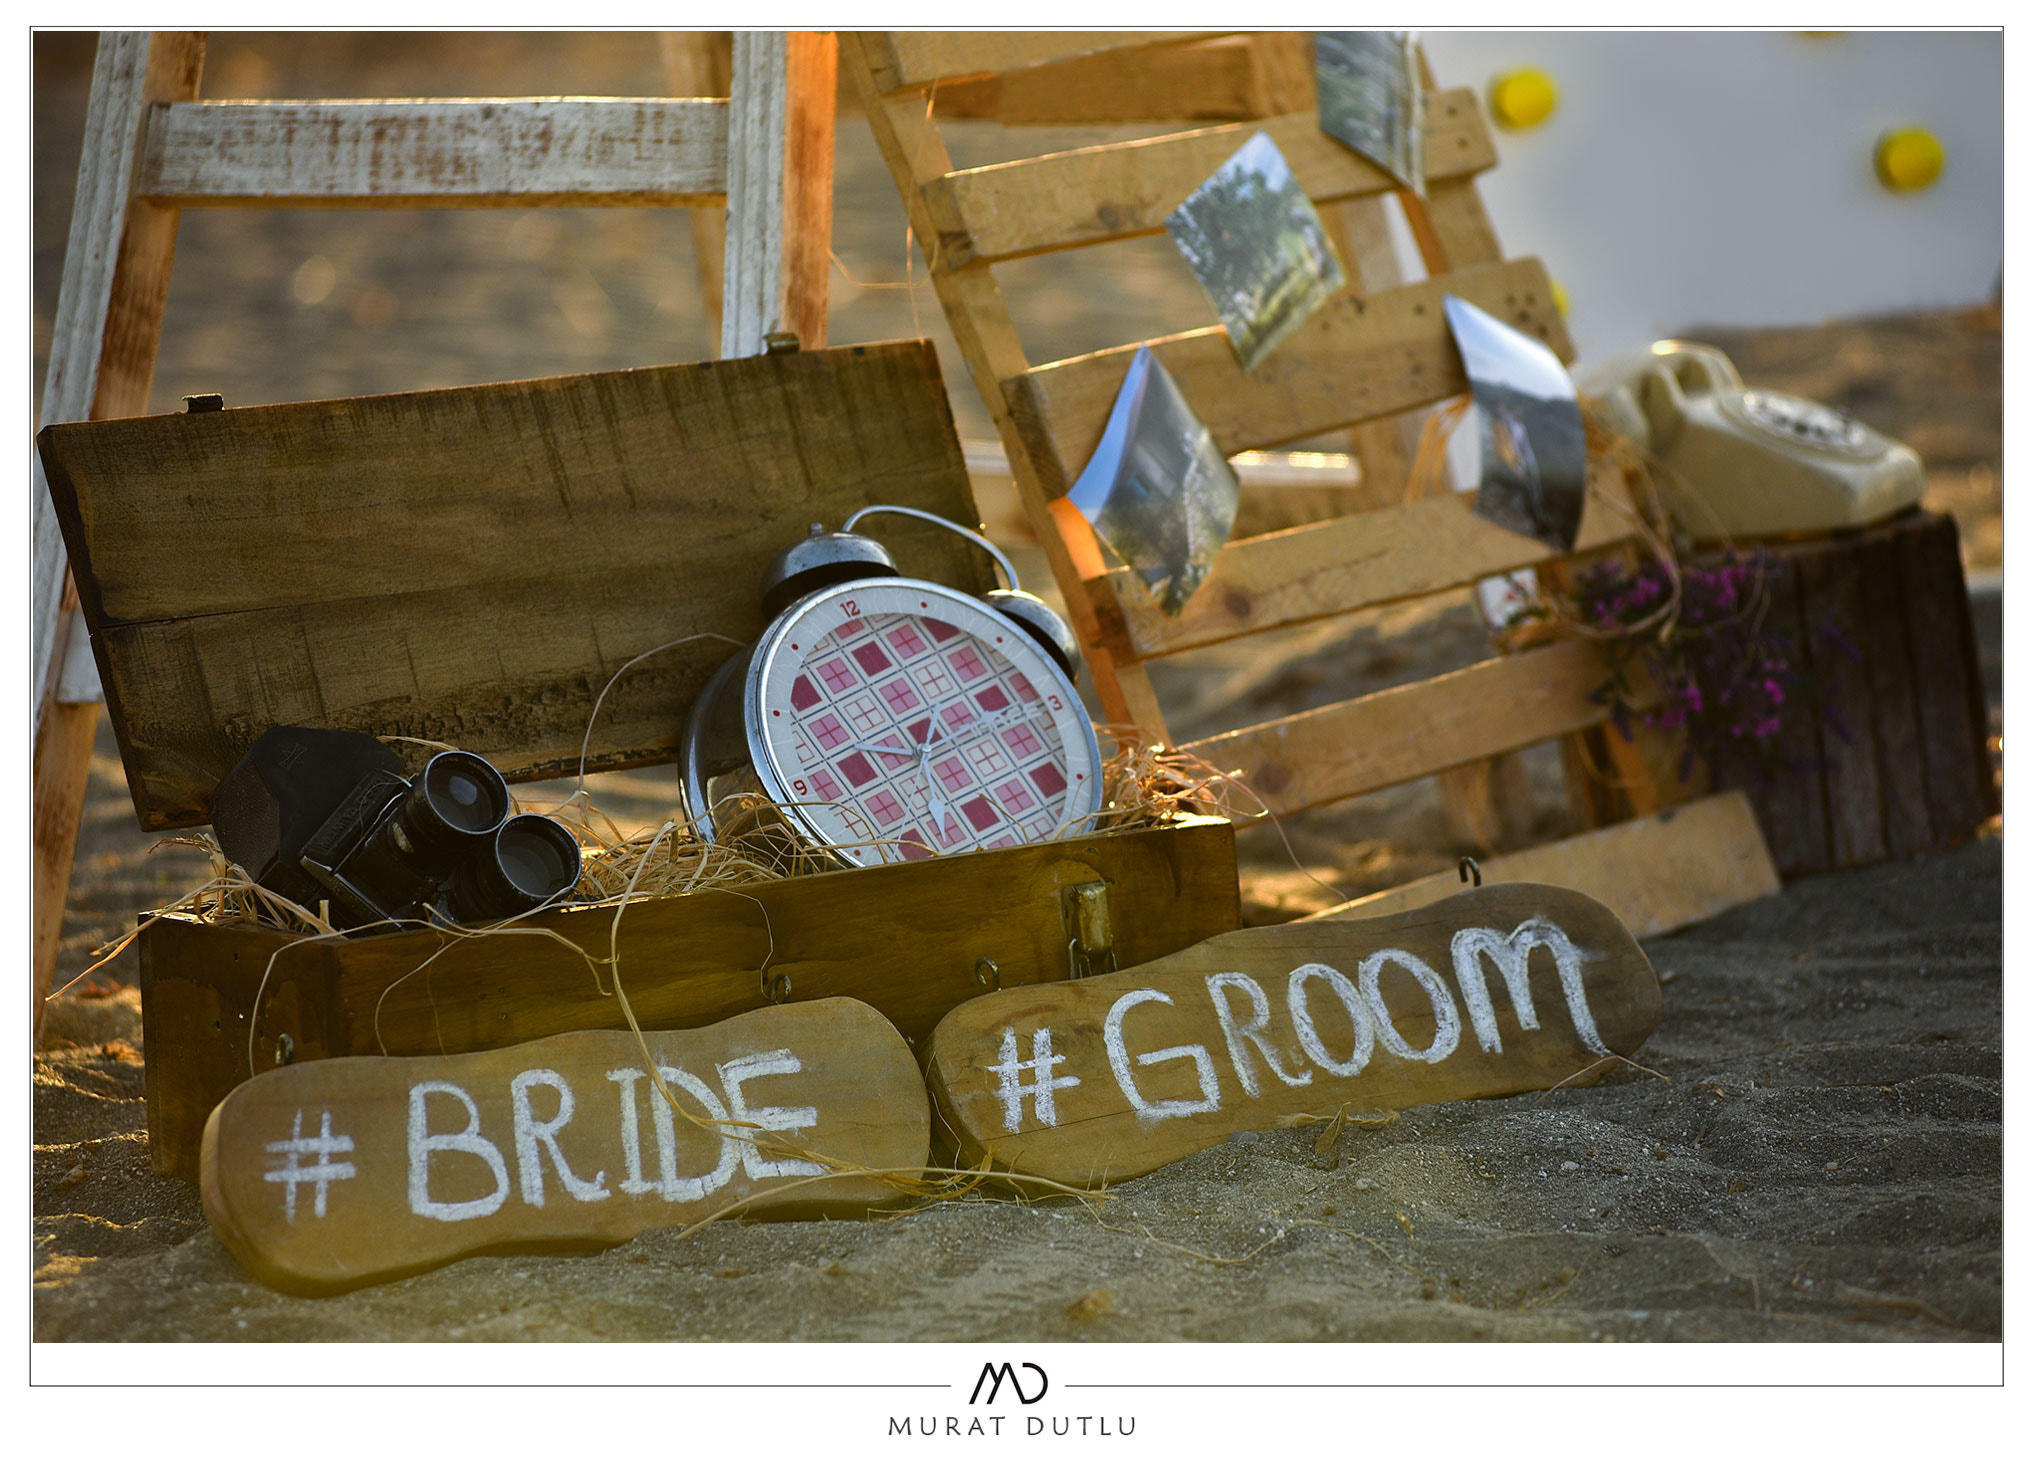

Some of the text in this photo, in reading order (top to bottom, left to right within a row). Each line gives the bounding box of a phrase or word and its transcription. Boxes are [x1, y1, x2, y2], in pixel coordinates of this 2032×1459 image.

[840, 599, 861, 618] 12
[1047, 695, 1063, 711] 3
[793, 779, 808, 796] 9
